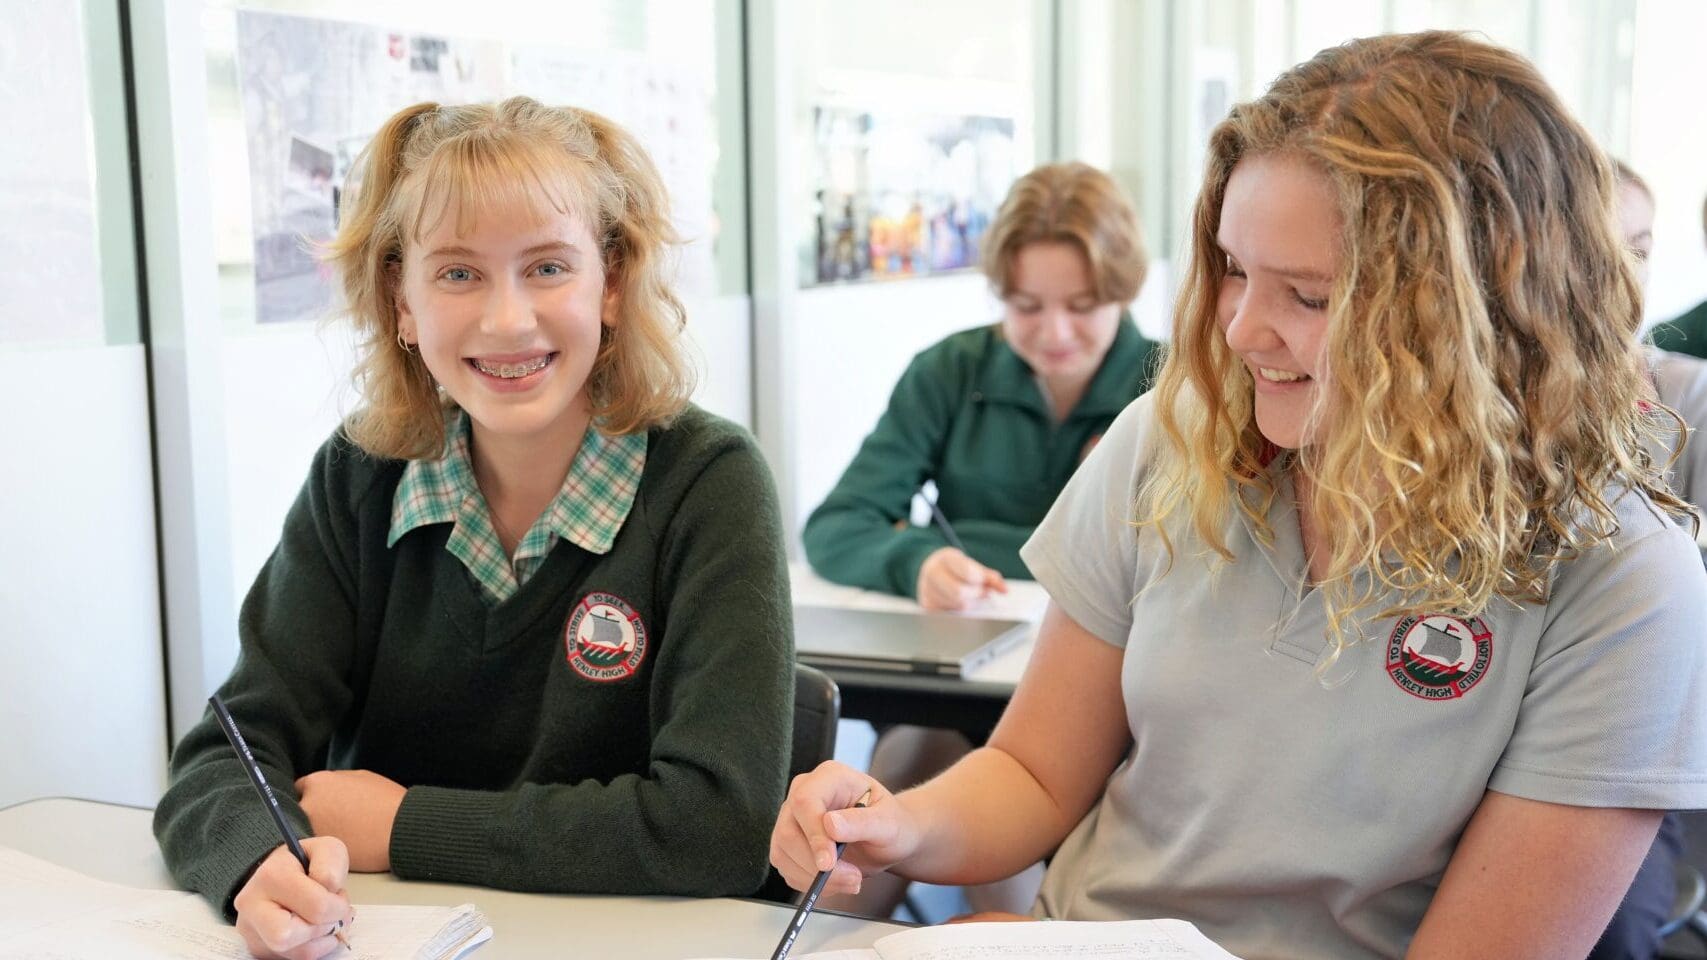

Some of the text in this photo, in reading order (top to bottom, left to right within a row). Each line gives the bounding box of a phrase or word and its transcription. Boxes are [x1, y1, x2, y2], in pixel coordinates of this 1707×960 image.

[569, 607, 585, 650] TO STRIVE
[1391, 616, 1415, 660] TO STRIVE
[574, 657, 626, 678] HENLEY HIGH
[1393, 668, 1453, 697] HENLEY HIGH
[1459, 641, 1489, 689] NOT TO YIELD
